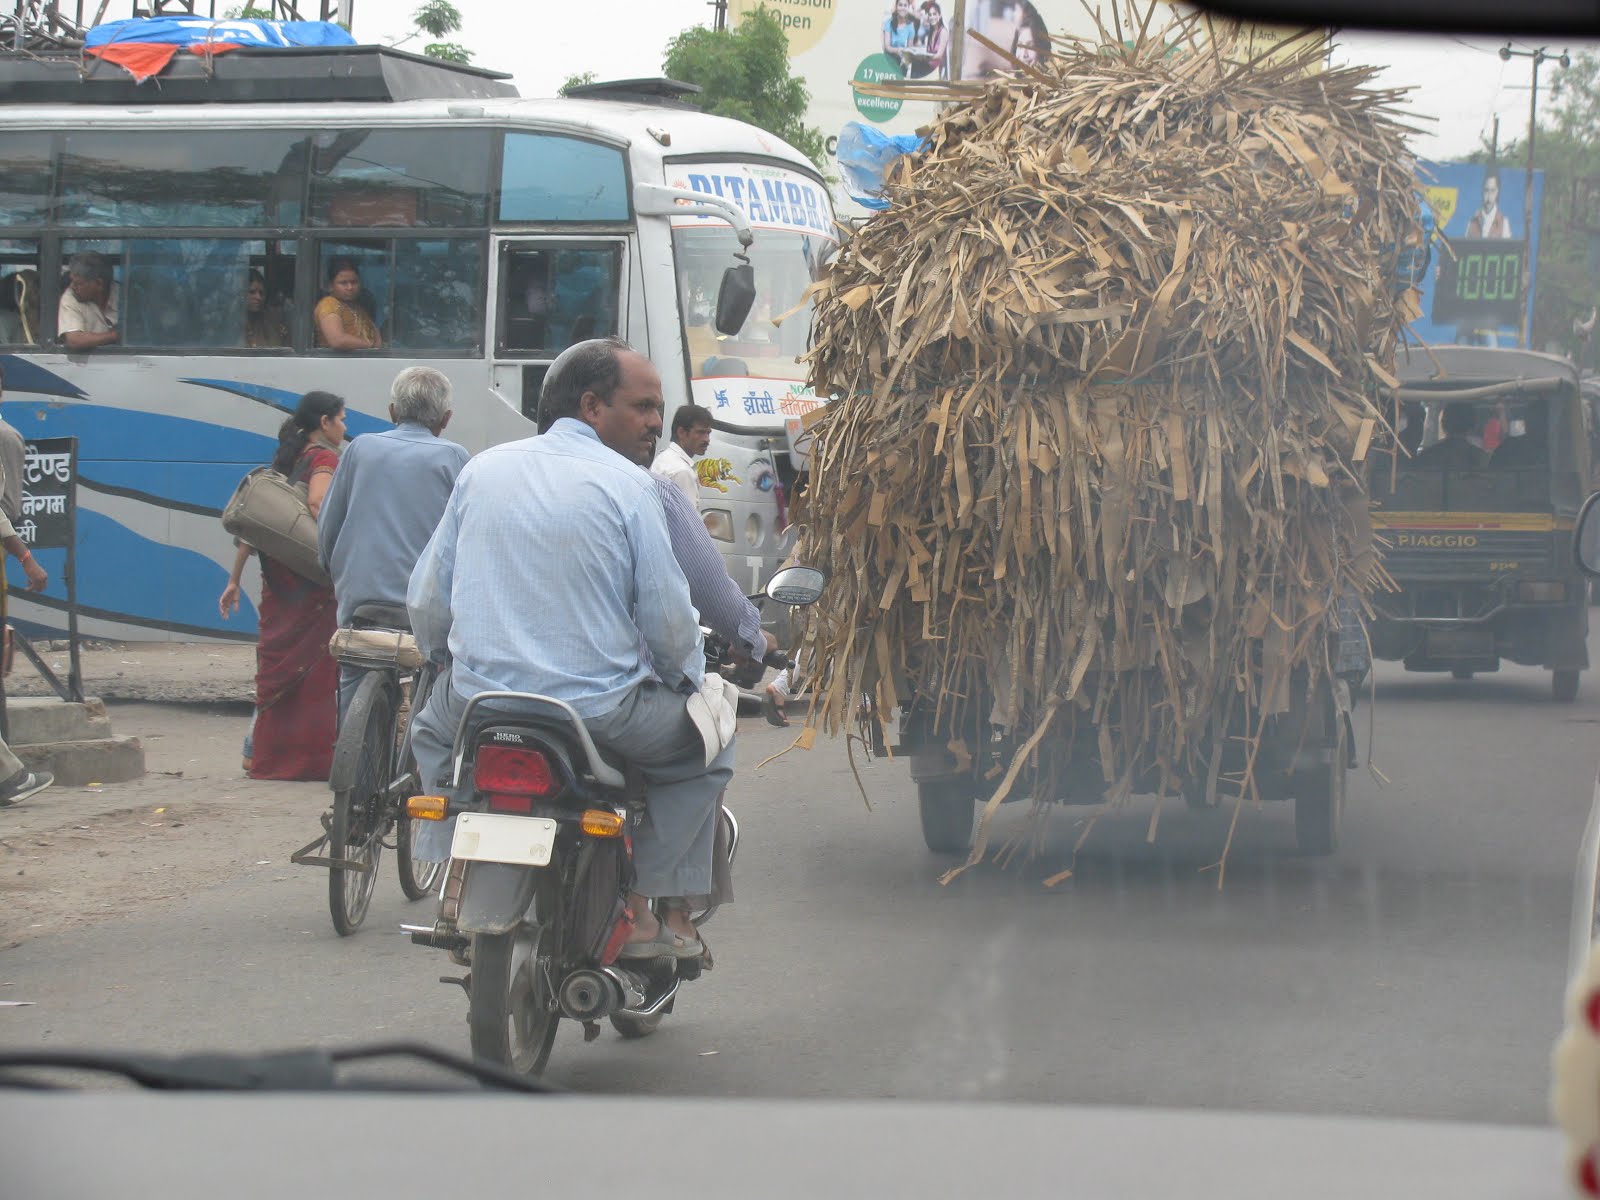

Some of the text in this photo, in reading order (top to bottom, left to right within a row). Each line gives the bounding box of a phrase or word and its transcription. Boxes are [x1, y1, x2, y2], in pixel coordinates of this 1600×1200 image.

[863, 68, 897, 83] 17 years
[857, 96, 899, 110] excellence
[1456, 253, 1519, 300] 1000
[1398, 535, 1477, 547] PIAGGIO
